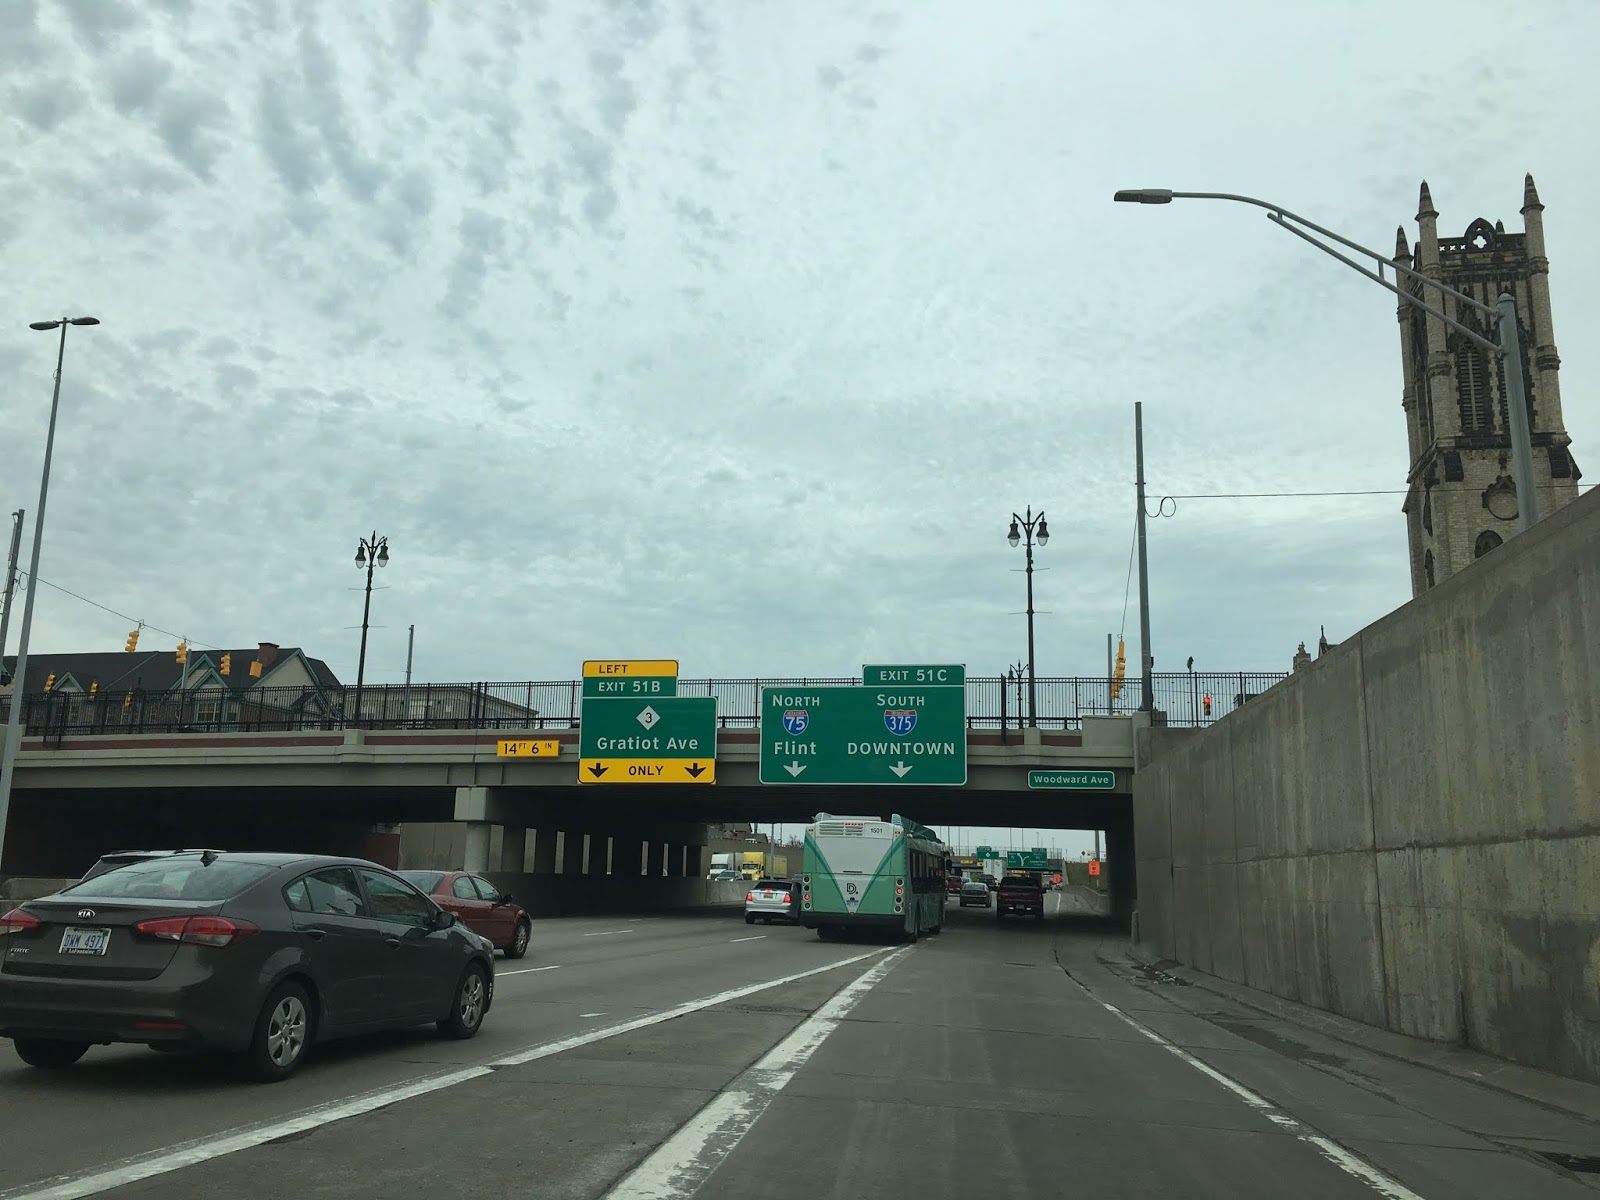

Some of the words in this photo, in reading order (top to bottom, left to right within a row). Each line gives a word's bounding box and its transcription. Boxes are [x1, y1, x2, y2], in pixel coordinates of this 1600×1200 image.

[598, 664, 628, 674] LEFT
[880, 670, 910, 681] EXIT
[916, 669, 948, 682] 51C
[598, 682, 626, 692] EXIT
[632, 680, 661, 693] 51B
[644, 712, 653, 724] 3
[785, 716, 806, 731] 75
[889, 716, 912, 731] 375
[504, 743, 518, 755] 14
[531, 742, 540, 754] 6
[597, 736, 660, 750] Gratiot
[666, 737, 699, 750] Ave
[774, 740, 817, 755] Flint
[847, 742, 956, 756] DOWNTOWN
[628, 765, 664, 776] ONLY
[1034, 775, 1088, 784] Woodward
[1090, 776, 1109, 784] Ave
[77, 910, 92, 918] KIA
[64, 934, 82, 947] DWM
